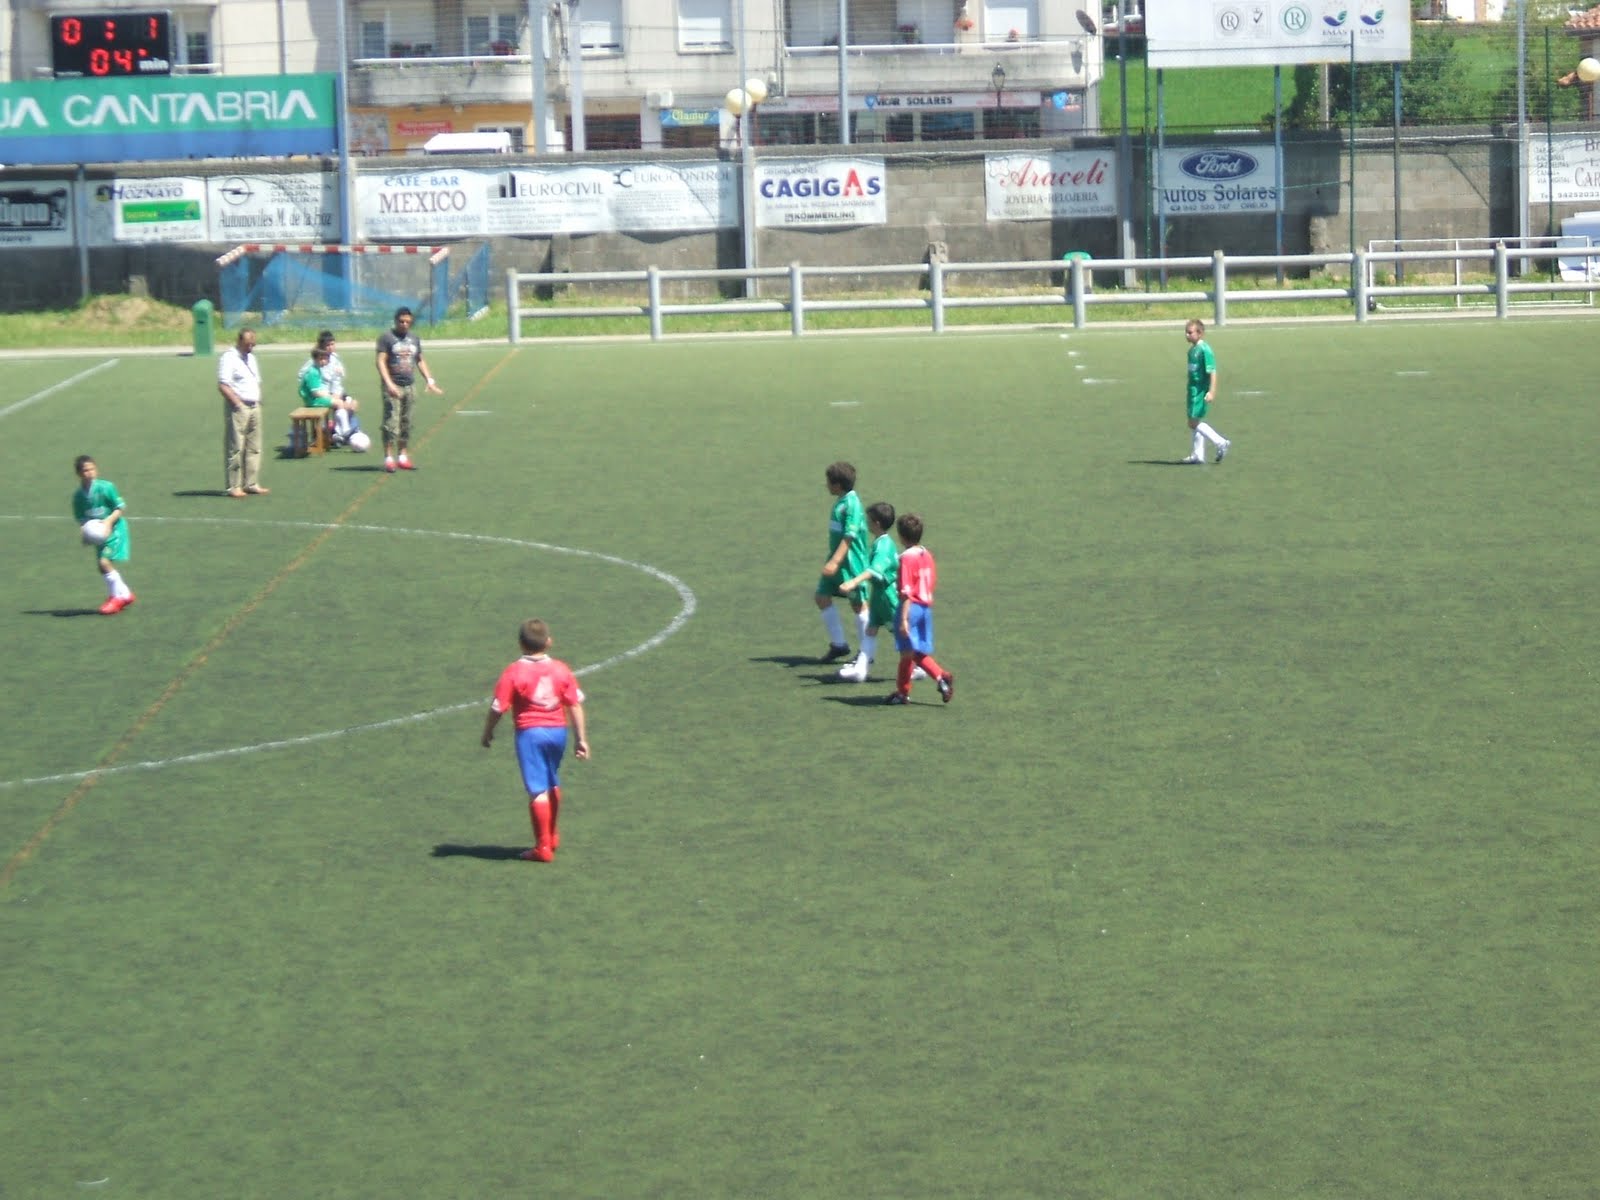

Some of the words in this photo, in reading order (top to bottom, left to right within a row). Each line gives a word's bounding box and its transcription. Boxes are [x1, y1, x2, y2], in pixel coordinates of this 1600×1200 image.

[63, 89, 317, 128] CANTABRIA
[906, 94, 954, 106] SOLARES
[1000, 158, 1109, 188] Araceli
[1195, 153, 1242, 174] Ford
[520, 181, 605, 197] EUROCIVIL
[759, 167, 881, 198] CAGIGAS
[1213, 183, 1277, 201] Solares
[378, 189, 467, 214] MEXICO
[531, 675, 561, 711] 4
